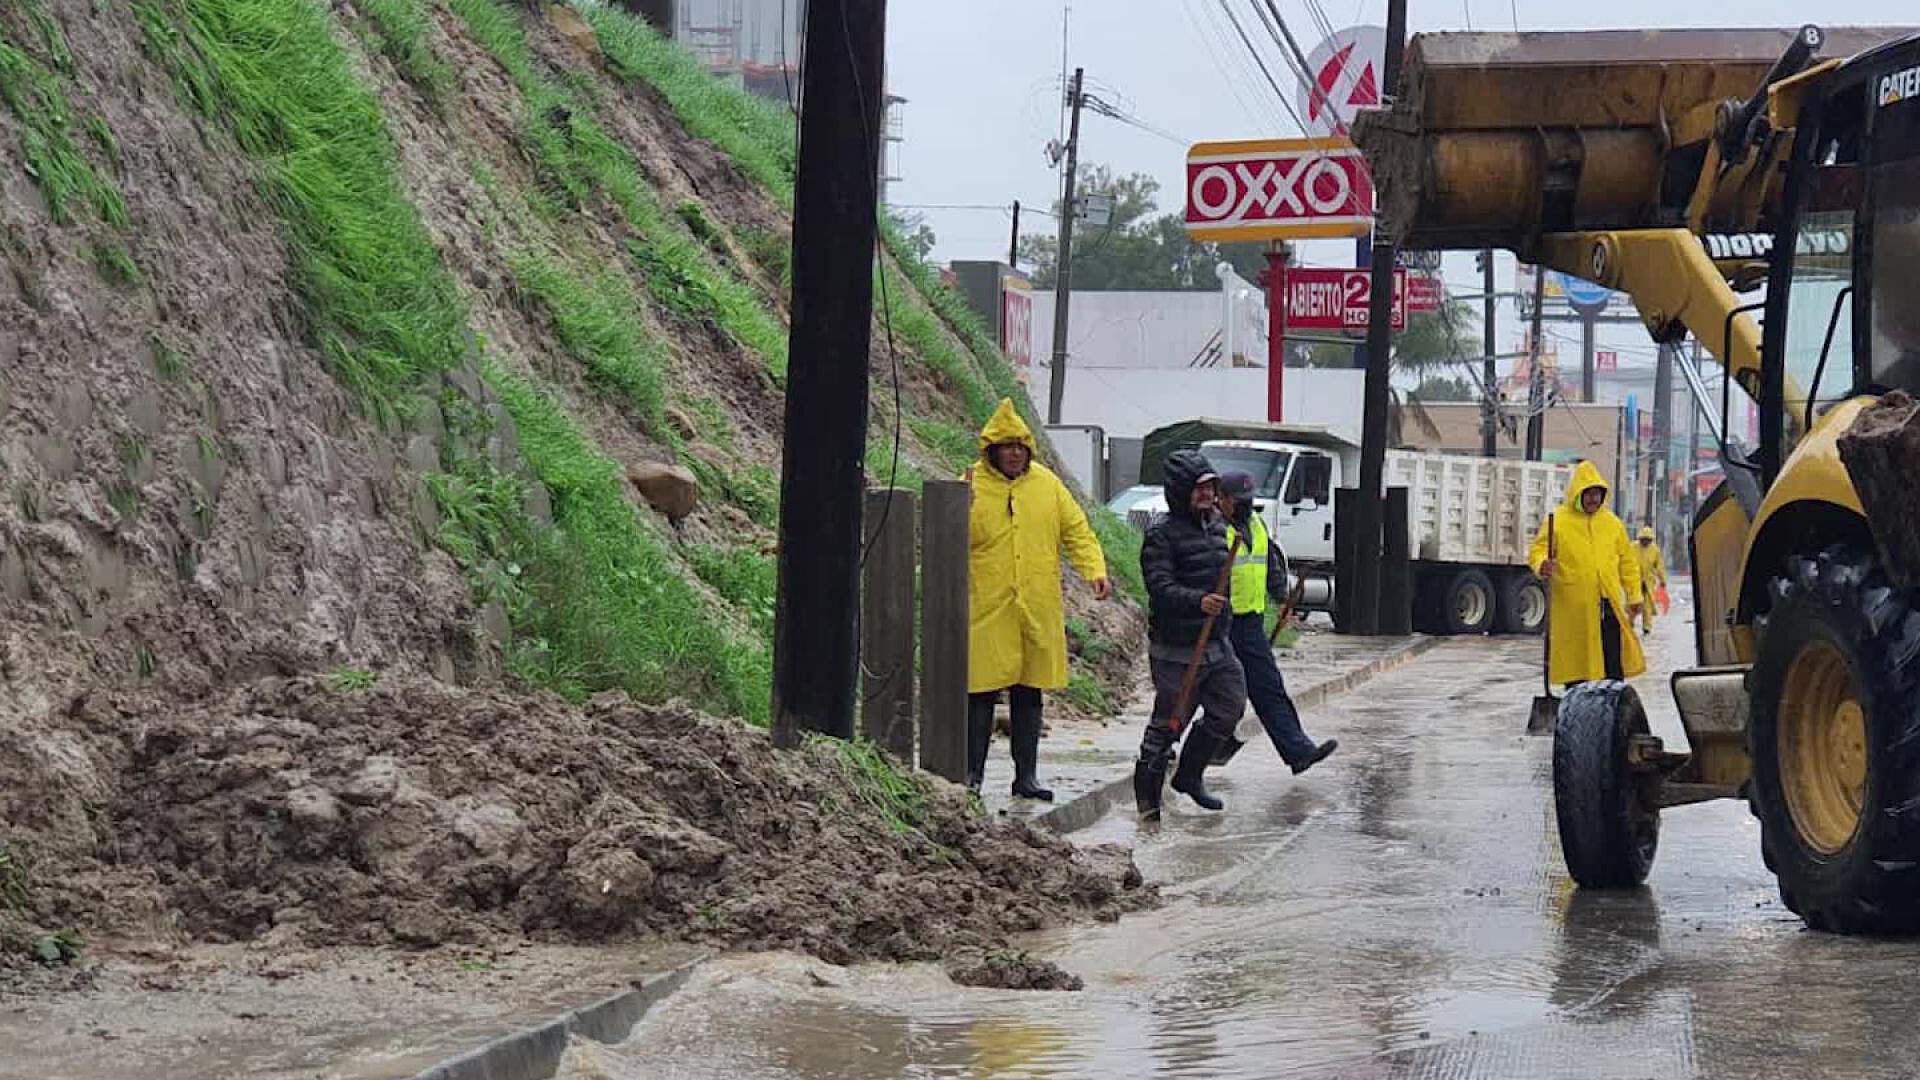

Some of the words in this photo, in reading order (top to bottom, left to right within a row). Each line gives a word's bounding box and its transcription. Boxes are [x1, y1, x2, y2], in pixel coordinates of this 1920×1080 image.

[1192, 157, 1350, 222] OXXO
[1291, 283, 1342, 317] ABIERTO
[1345, 310, 1400, 323] HOS
